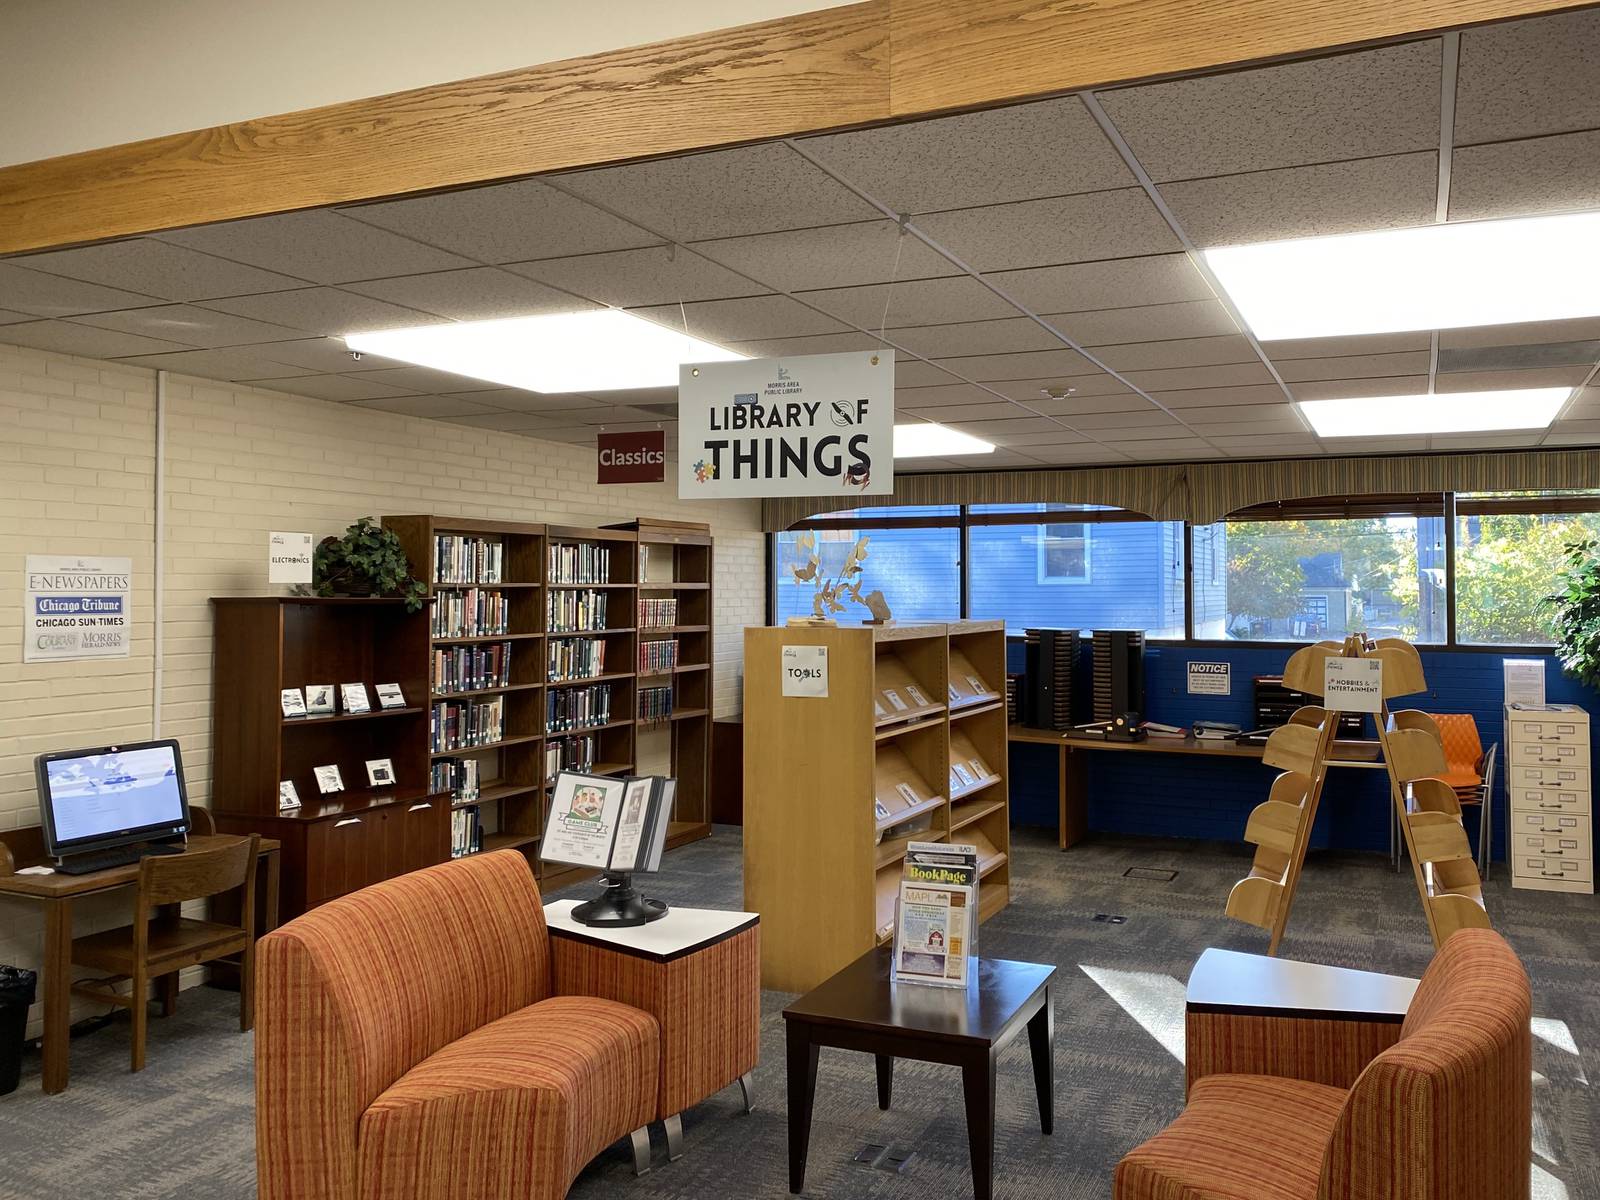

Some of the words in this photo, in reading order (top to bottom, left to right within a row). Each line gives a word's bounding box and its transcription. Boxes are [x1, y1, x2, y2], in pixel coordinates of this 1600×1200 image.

[710, 401, 821, 431] LIBRARY
[599, 447, 664, 467] Classics
[704, 433, 871, 486] THINGS
[29, 575, 128, 590] E-NEWSPAPERS
[39, 598, 80, 612] Chicago
[81, 598, 120, 612] Tribune
[35, 618, 76, 628] CHICAGO
[82, 632, 122, 643] MORRIS
[787, 668, 822, 679] TOOLS
[1190, 663, 1228, 673] NOTICE
[1328, 685, 1378, 693] ENTERTAINMENT
[909, 866, 967, 884] BookPage
